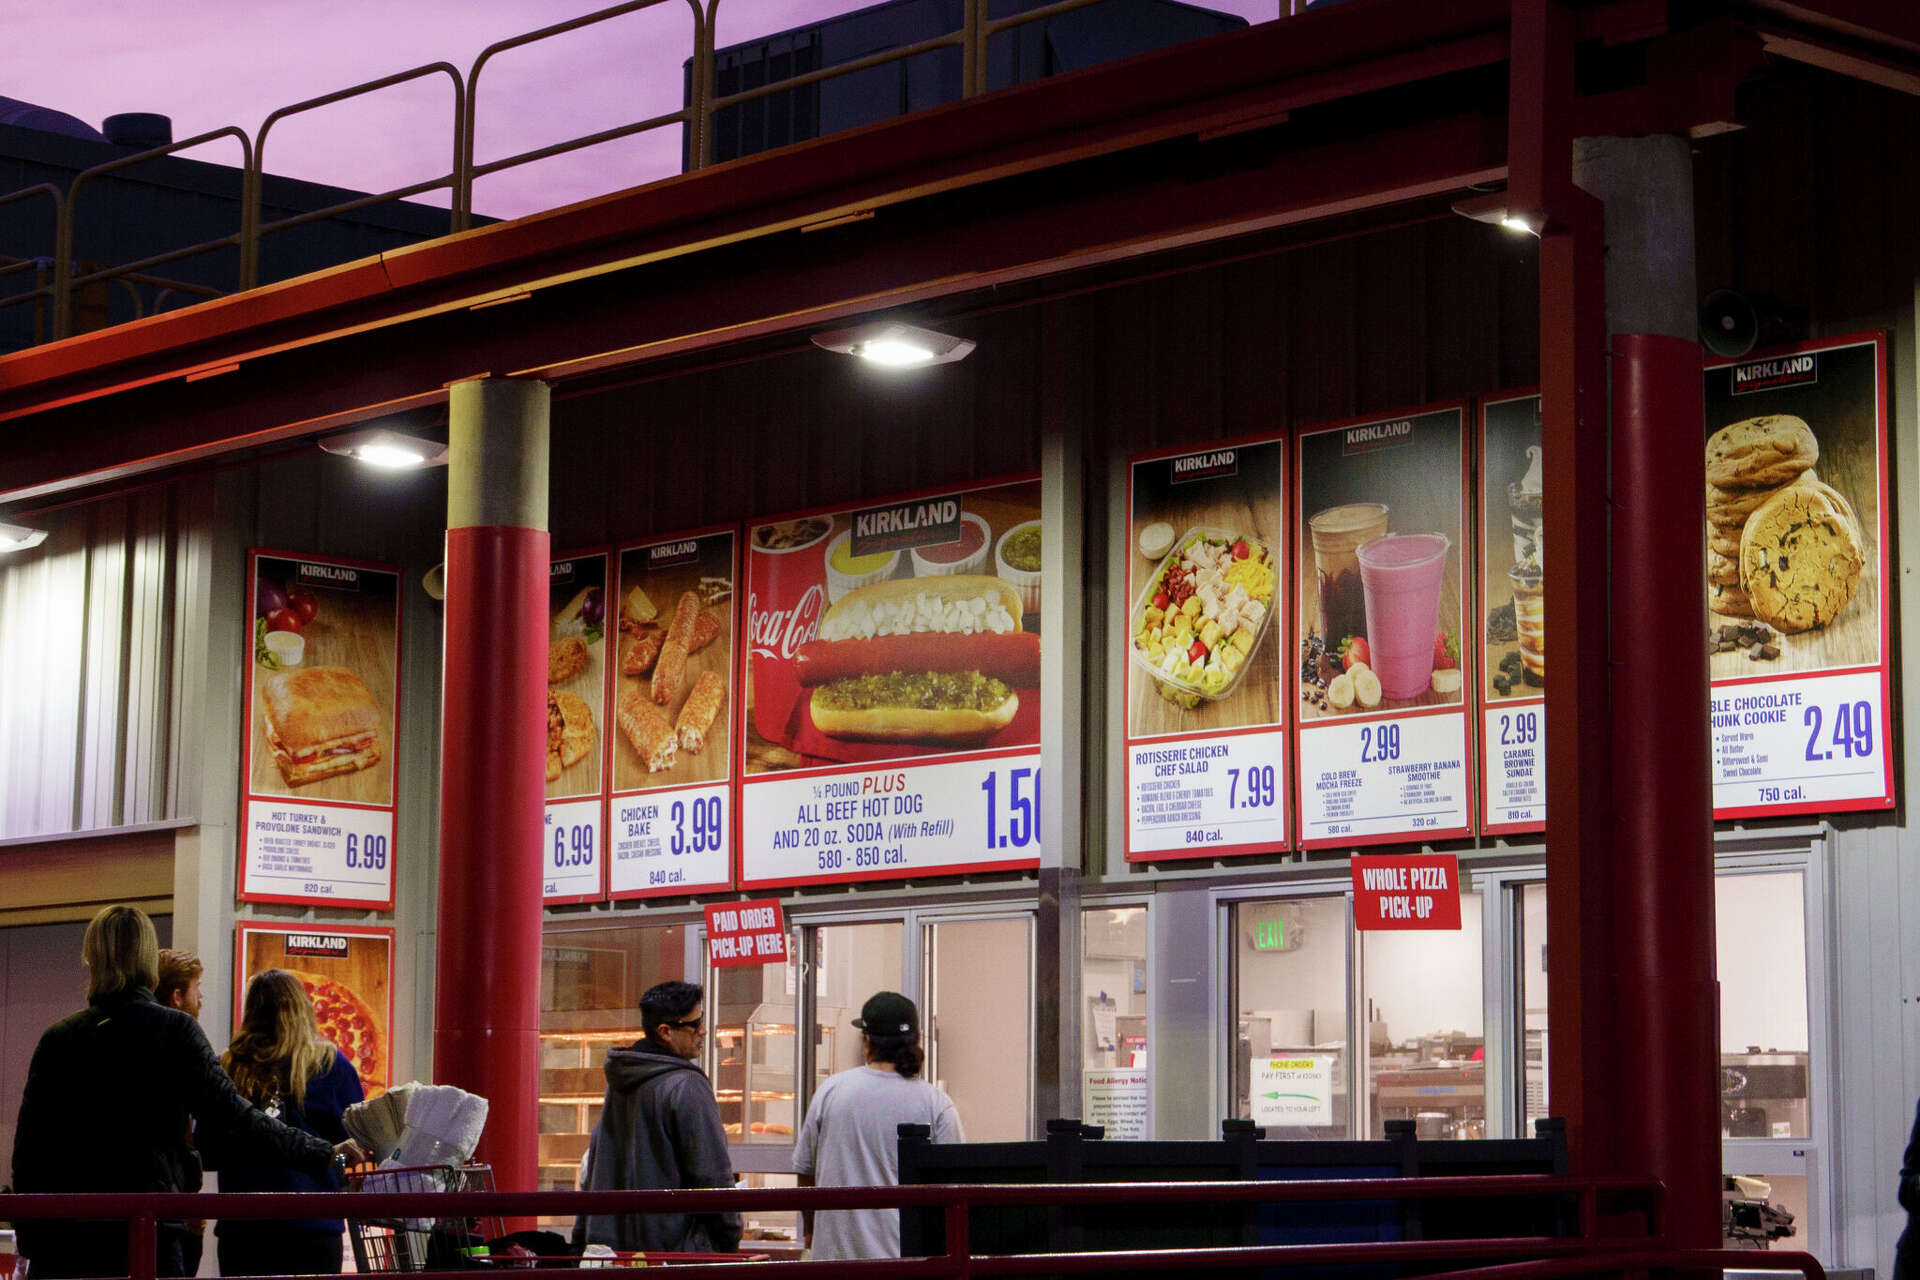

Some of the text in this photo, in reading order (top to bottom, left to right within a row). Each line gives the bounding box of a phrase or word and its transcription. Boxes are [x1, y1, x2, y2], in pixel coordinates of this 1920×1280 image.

[1736, 356, 1814, 382] KIRKLAND
[1347, 421, 1411, 444] KIRKLAND
[1175, 451, 1235, 472] KIRKLAND
[857, 501, 957, 537] KIRKLAND
[651, 541, 697, 560] KIRKLAND
[300, 564, 357, 582] KIRKLAND
[550, 562, 572, 576] LAND
[1711, 692, 1802, 712] BLE CHOCOLATE
[1500, 712, 1536, 745] 2.99
[1711, 710, 1786, 728] HUNK COOKIE
[1804, 701, 1873, 761] 2.49
[1361, 724, 1400, 763] 2.99
[1136, 744, 1228, 765] ROTISSERIE CHICKEN
[1504, 748, 1534, 759] CARAMEL
[1155, 761, 1208, 777] CHEF SALAD
[1388, 760, 1460, 775] STRAWBERRY BANANA
[1504, 758, 1535, 769] BROWNIE
[1506, 768, 1533, 778] SUNDAE
[1316, 778, 1362, 790] MOCHA FREEZE
[1322, 770, 1356, 780] COLD BREW
[1408, 771, 1440, 782] SMOOTHIE
[825, 781, 860, 798] POUND
[862, 774, 906, 795] PLUS
[1228, 765, 1274, 809] 7.99
[1758, 785, 1806, 801] 750 cal.
[272, 812, 326, 824] HOT TURKEY &
[621, 804, 658, 822] CHICKEN
[798, 794, 923, 824] ALL BEEF HOT DOG
[1521, 810, 1532, 819] cal.
[256, 822, 342, 837] PROVOLONE SANDWICH
[628, 822, 651, 837] BAKE
[671, 796, 722, 855] 3.99
[773, 819, 954, 849] AND 20 oz. SODA (With Refill)
[554, 824, 593, 867] 6.99
[1186, 829, 1223, 843] 840 cal.
[346, 833, 386, 870] 6.99
[818, 849, 842, 869] 580
[856, 846, 879, 866] 850
[884, 844, 907, 864] cal.
[650, 868, 686, 885] 840 cal.
[1362, 867, 1448, 890] WHOLE PIZZA
[304, 884, 335, 894] 820 cal.
[1380, 896, 1433, 919] PICK-UP
[712, 907, 775, 932] PAID ORDER
[288, 936, 346, 950] KIRKLAND
[1258, 920, 1284, 948] EXIT
[711, 933, 784, 959] PICK-UP HERE
[1262, 1072, 1274, 1080] PAY
[1276, 1072, 1296, 1080] FIRST
